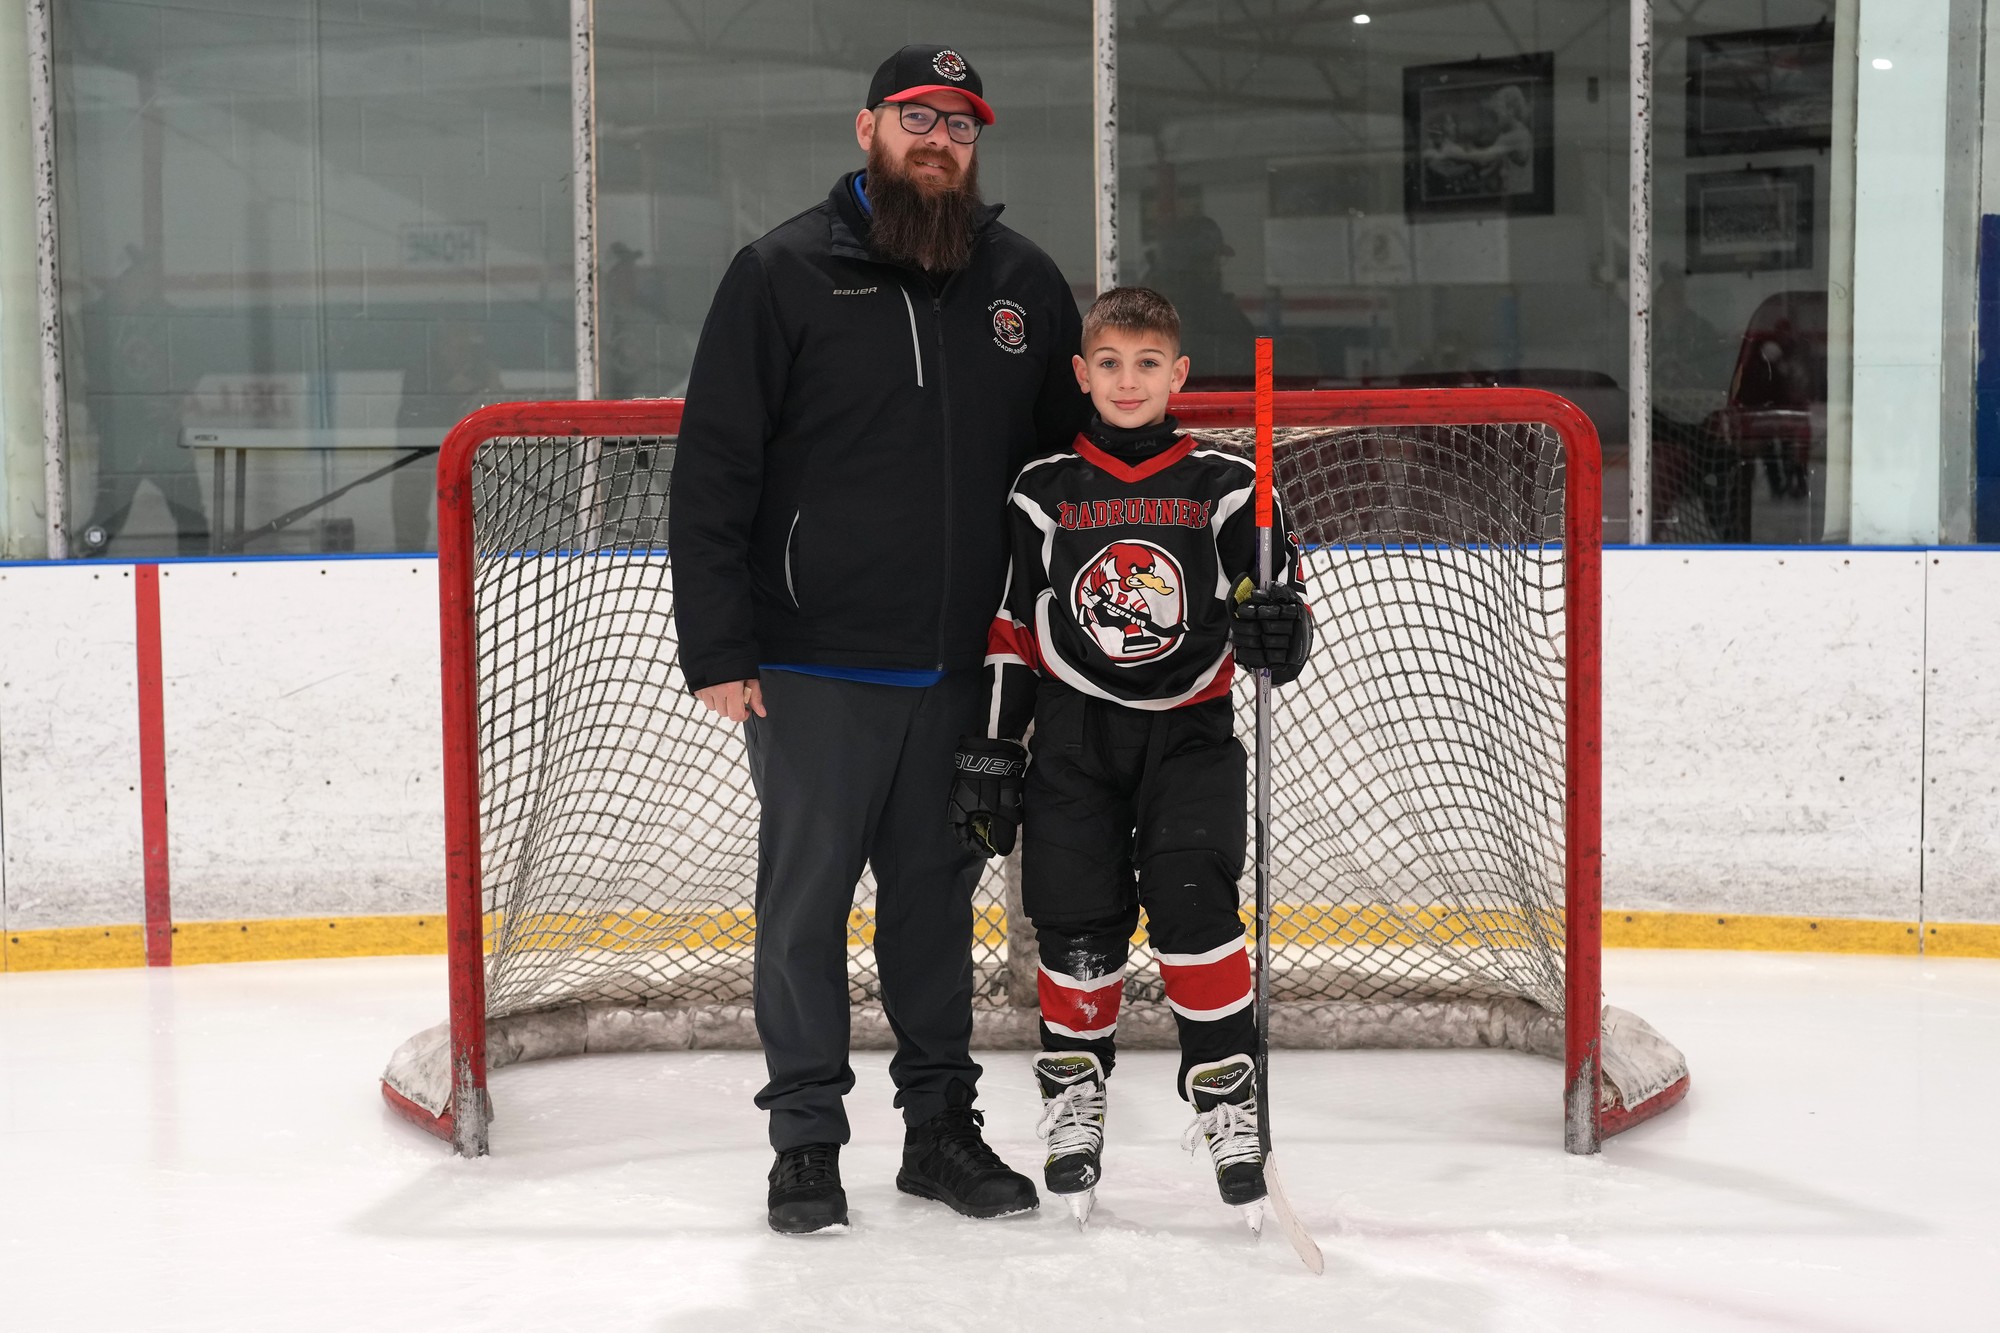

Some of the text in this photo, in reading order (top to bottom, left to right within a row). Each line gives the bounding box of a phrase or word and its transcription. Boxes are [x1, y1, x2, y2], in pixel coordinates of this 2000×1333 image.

[987, 299, 1027, 317] PLATTSBURGH
[1115, 592, 1128, 606] P
[1042, 1062, 1085, 1071] VAPOR
[1199, 1068, 1243, 1083] VAPOR
